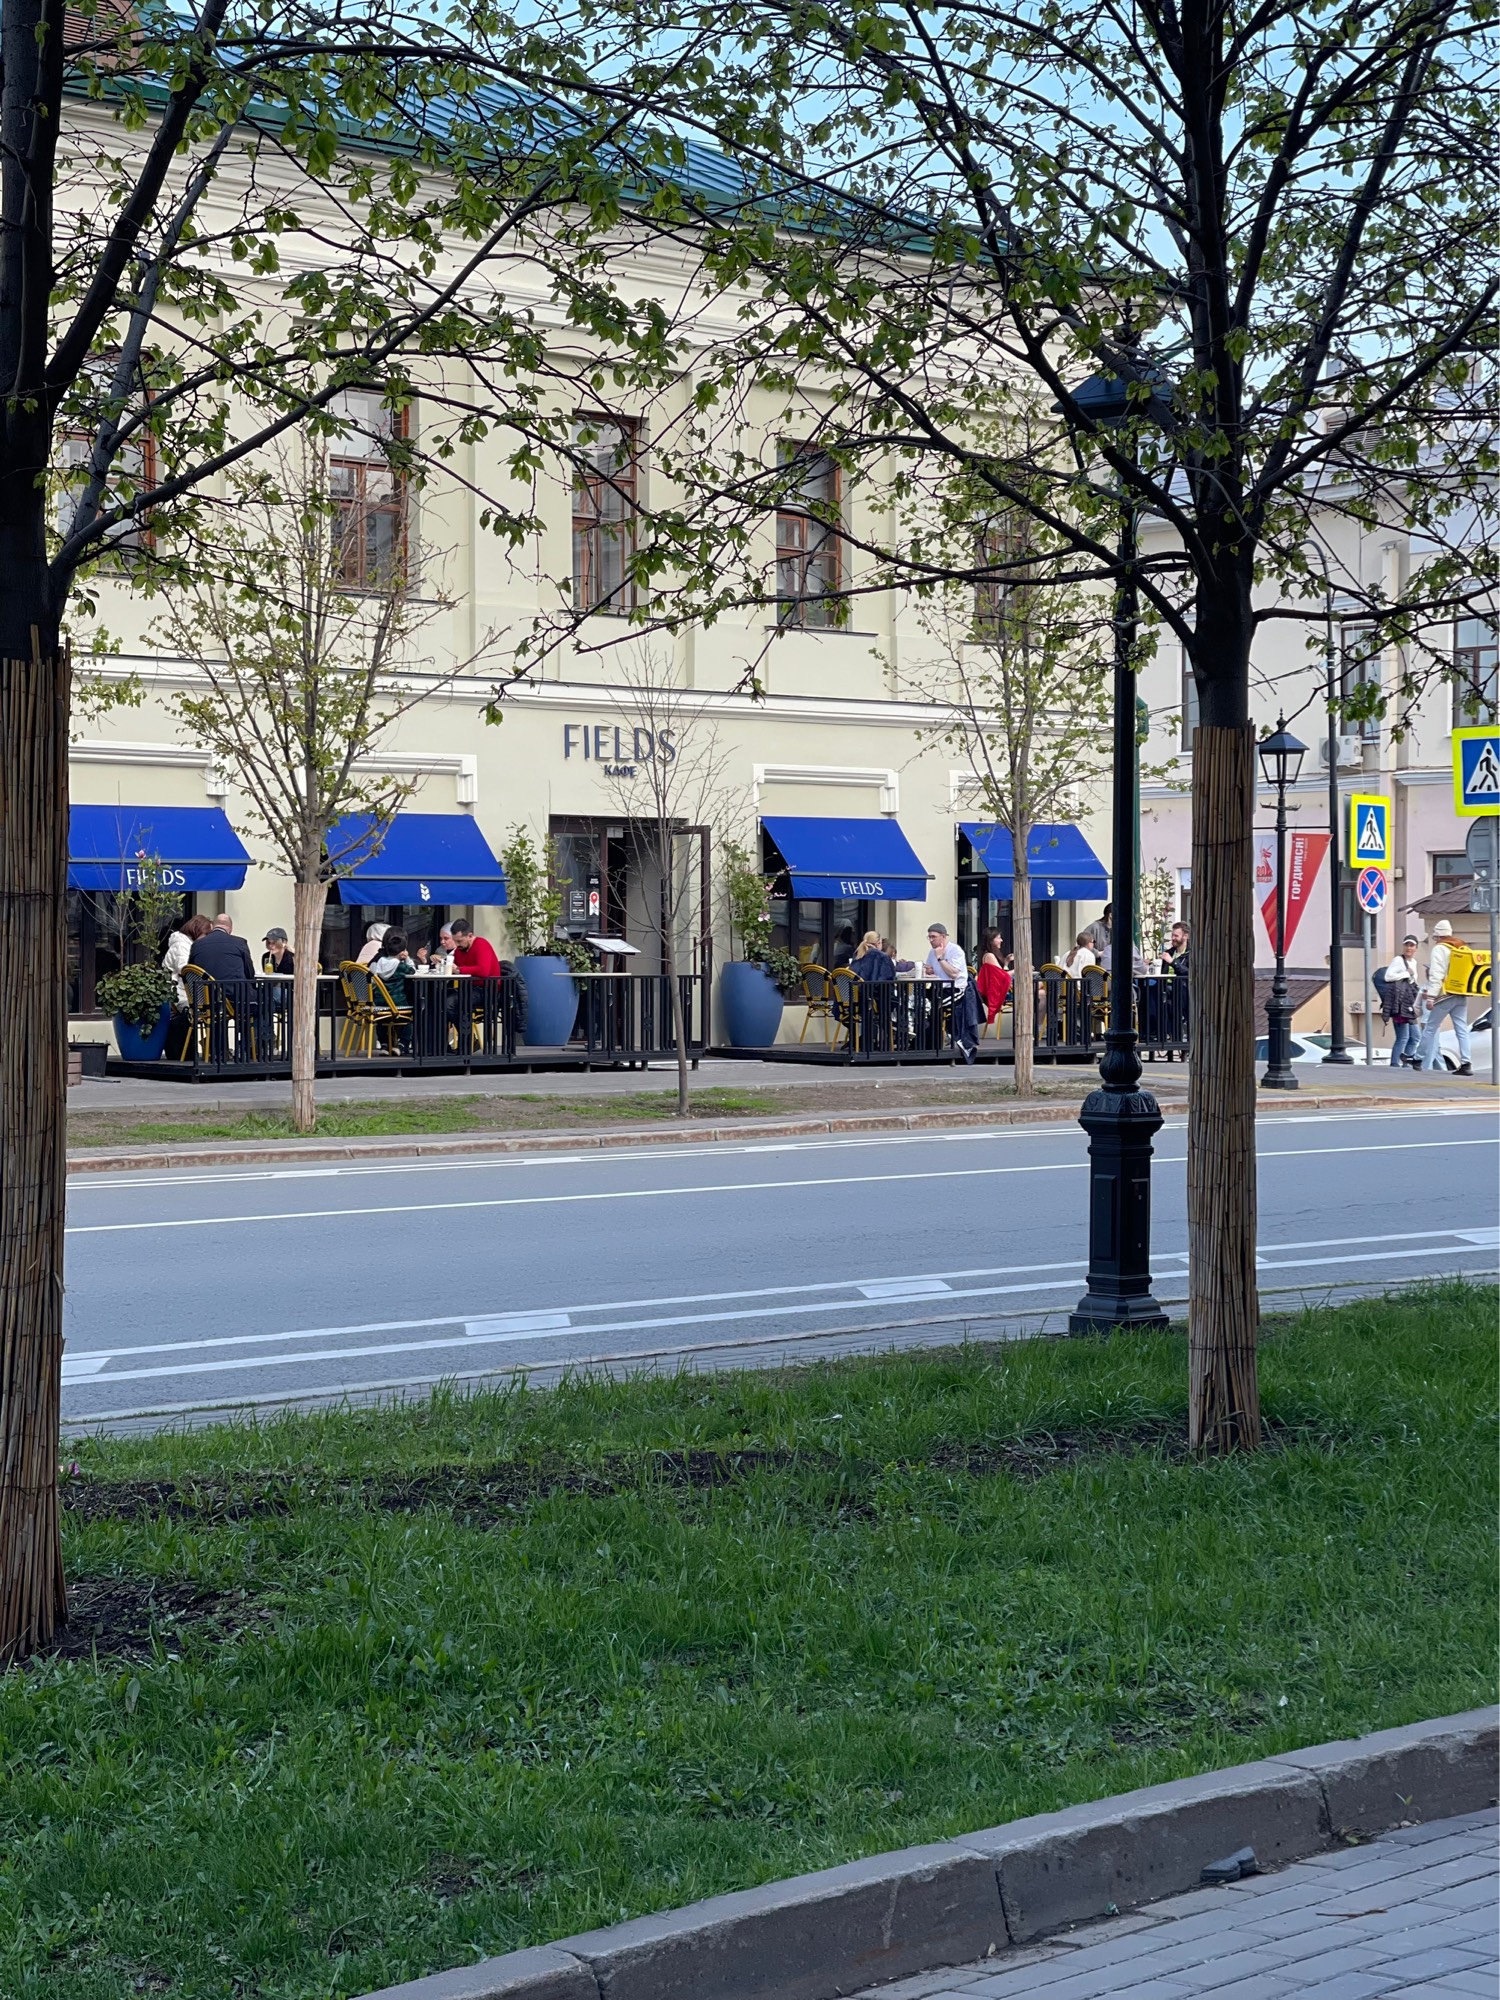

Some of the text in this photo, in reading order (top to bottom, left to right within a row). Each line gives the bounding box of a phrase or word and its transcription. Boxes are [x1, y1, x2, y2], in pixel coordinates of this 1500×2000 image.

[564, 724, 676, 763] FIELDS
[604, 764, 638, 778] КАФЕ
[1291, 837, 1305, 900] ГОРДИМСЯ!
[840, 881, 884, 896] FIELDS
